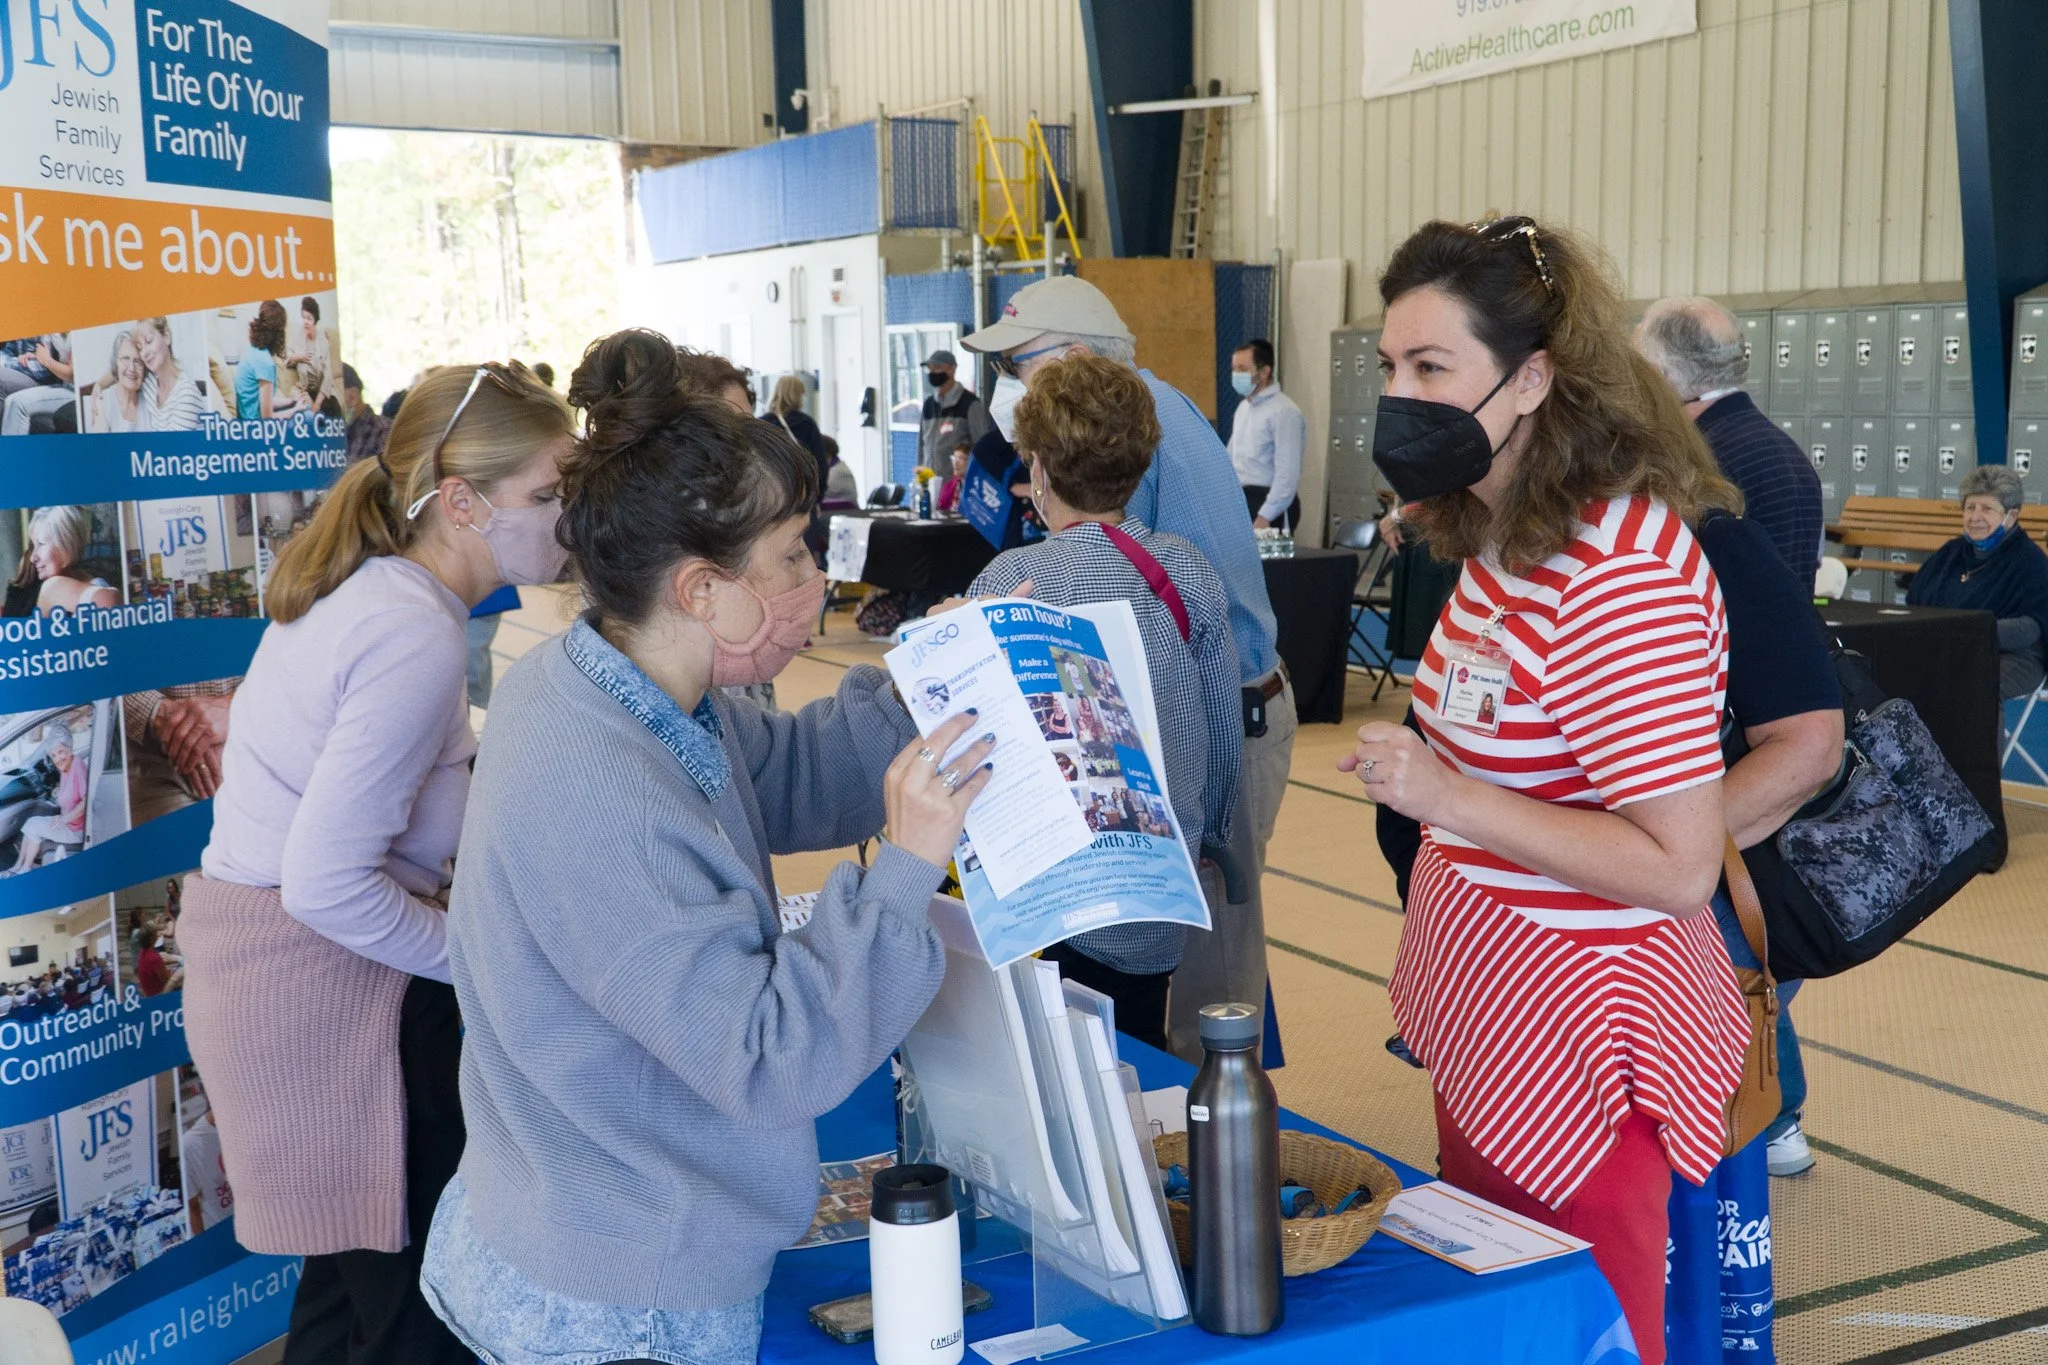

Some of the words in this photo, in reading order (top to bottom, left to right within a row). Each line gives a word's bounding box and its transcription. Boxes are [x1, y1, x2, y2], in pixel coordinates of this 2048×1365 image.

[146, 8, 195, 53] For
[198, 18, 253, 64] The
[1410, 5, 1635, 76] ActiveHealthcare.com
[51, 83, 120, 114] Jewish
[150, 61, 201, 107] Life
[207, 71, 240, 112] Of
[244, 76, 304, 121] Your
[55, 119, 121, 154] Family
[154, 114, 247, 172] Family
[39, 155, 125, 187] Services
[64, 216, 143, 272] me
[160, 208, 334, 283] about...
[200, 412, 287, 446] Therapy
[293, 412, 310, 438] &
[314, 413, 345, 438] Case
[131, 448, 279, 481] Management
[283, 444, 347, 471] Services
[160, 515, 207, 557] JFS
[0, 610, 41, 643] od
[50, 608, 71, 638] &
[77, 594, 173, 634] Financial
[1010, 607, 1034, 622] an
[1032, 605, 1072, 631] hour?
[1010, 633, 1049, 644] someone's
[945, 653, 997, 686] TRANSPORTATION
[1015, 671, 1058, 683] Difference
[1018, 658, 1042, 668] Make
[1043, 659, 1049, 667] a
[1068, 852, 1092, 861] shared
[1094, 849, 1116, 858] Jewish
[1090, 833, 1125, 849] with
[1127, 834, 1152, 849] JFS
[1045, 867, 1072, 881] through
[1072, 860, 1109, 873] leadership
[1032, 886, 1066, 901] information
[1074, 880, 1088, 888] how
[0, 993, 118, 1051] Outreach
[124, 984, 141, 1013] &
[0, 1021, 145, 1086] Community
[81, 1100, 133, 1162] JFS
[103, 1163, 133, 1182] Services
[108, 1152, 131, 1166] Family
